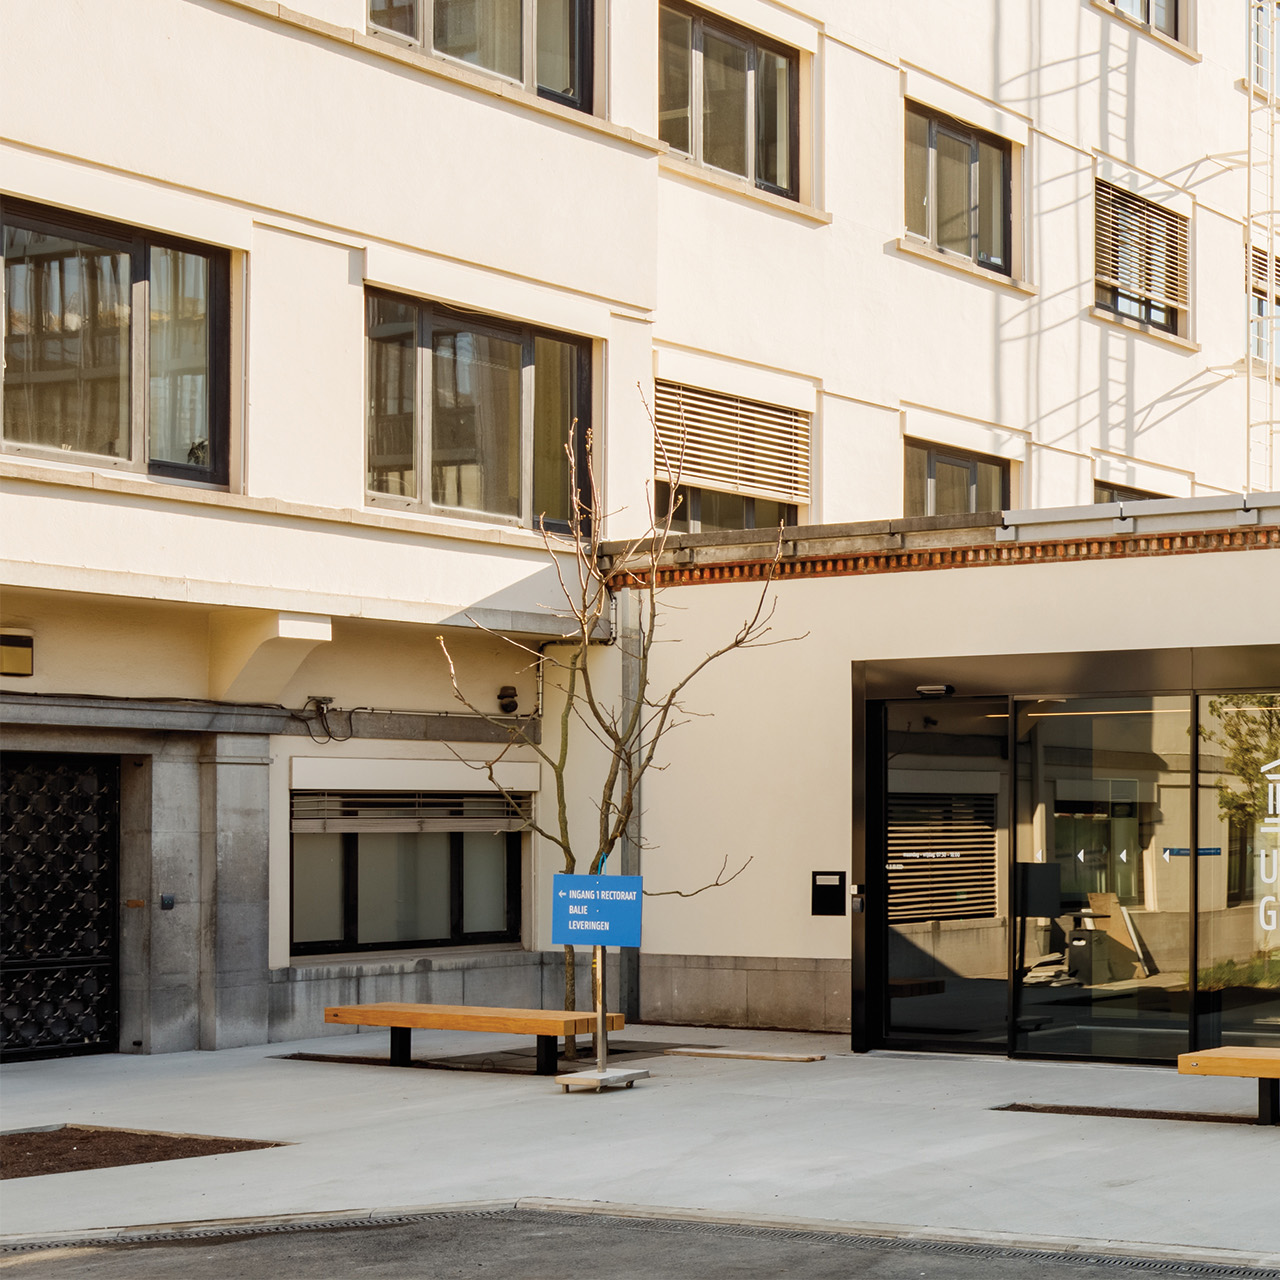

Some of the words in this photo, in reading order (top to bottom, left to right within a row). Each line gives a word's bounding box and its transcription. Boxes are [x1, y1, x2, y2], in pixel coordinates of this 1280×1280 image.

[569, 890, 595, 899] INGANG
[601, 891, 637, 900] RECTORAAT
[569, 905, 588, 914] BALIE
[568, 920, 609, 930] LEVERINGEN
